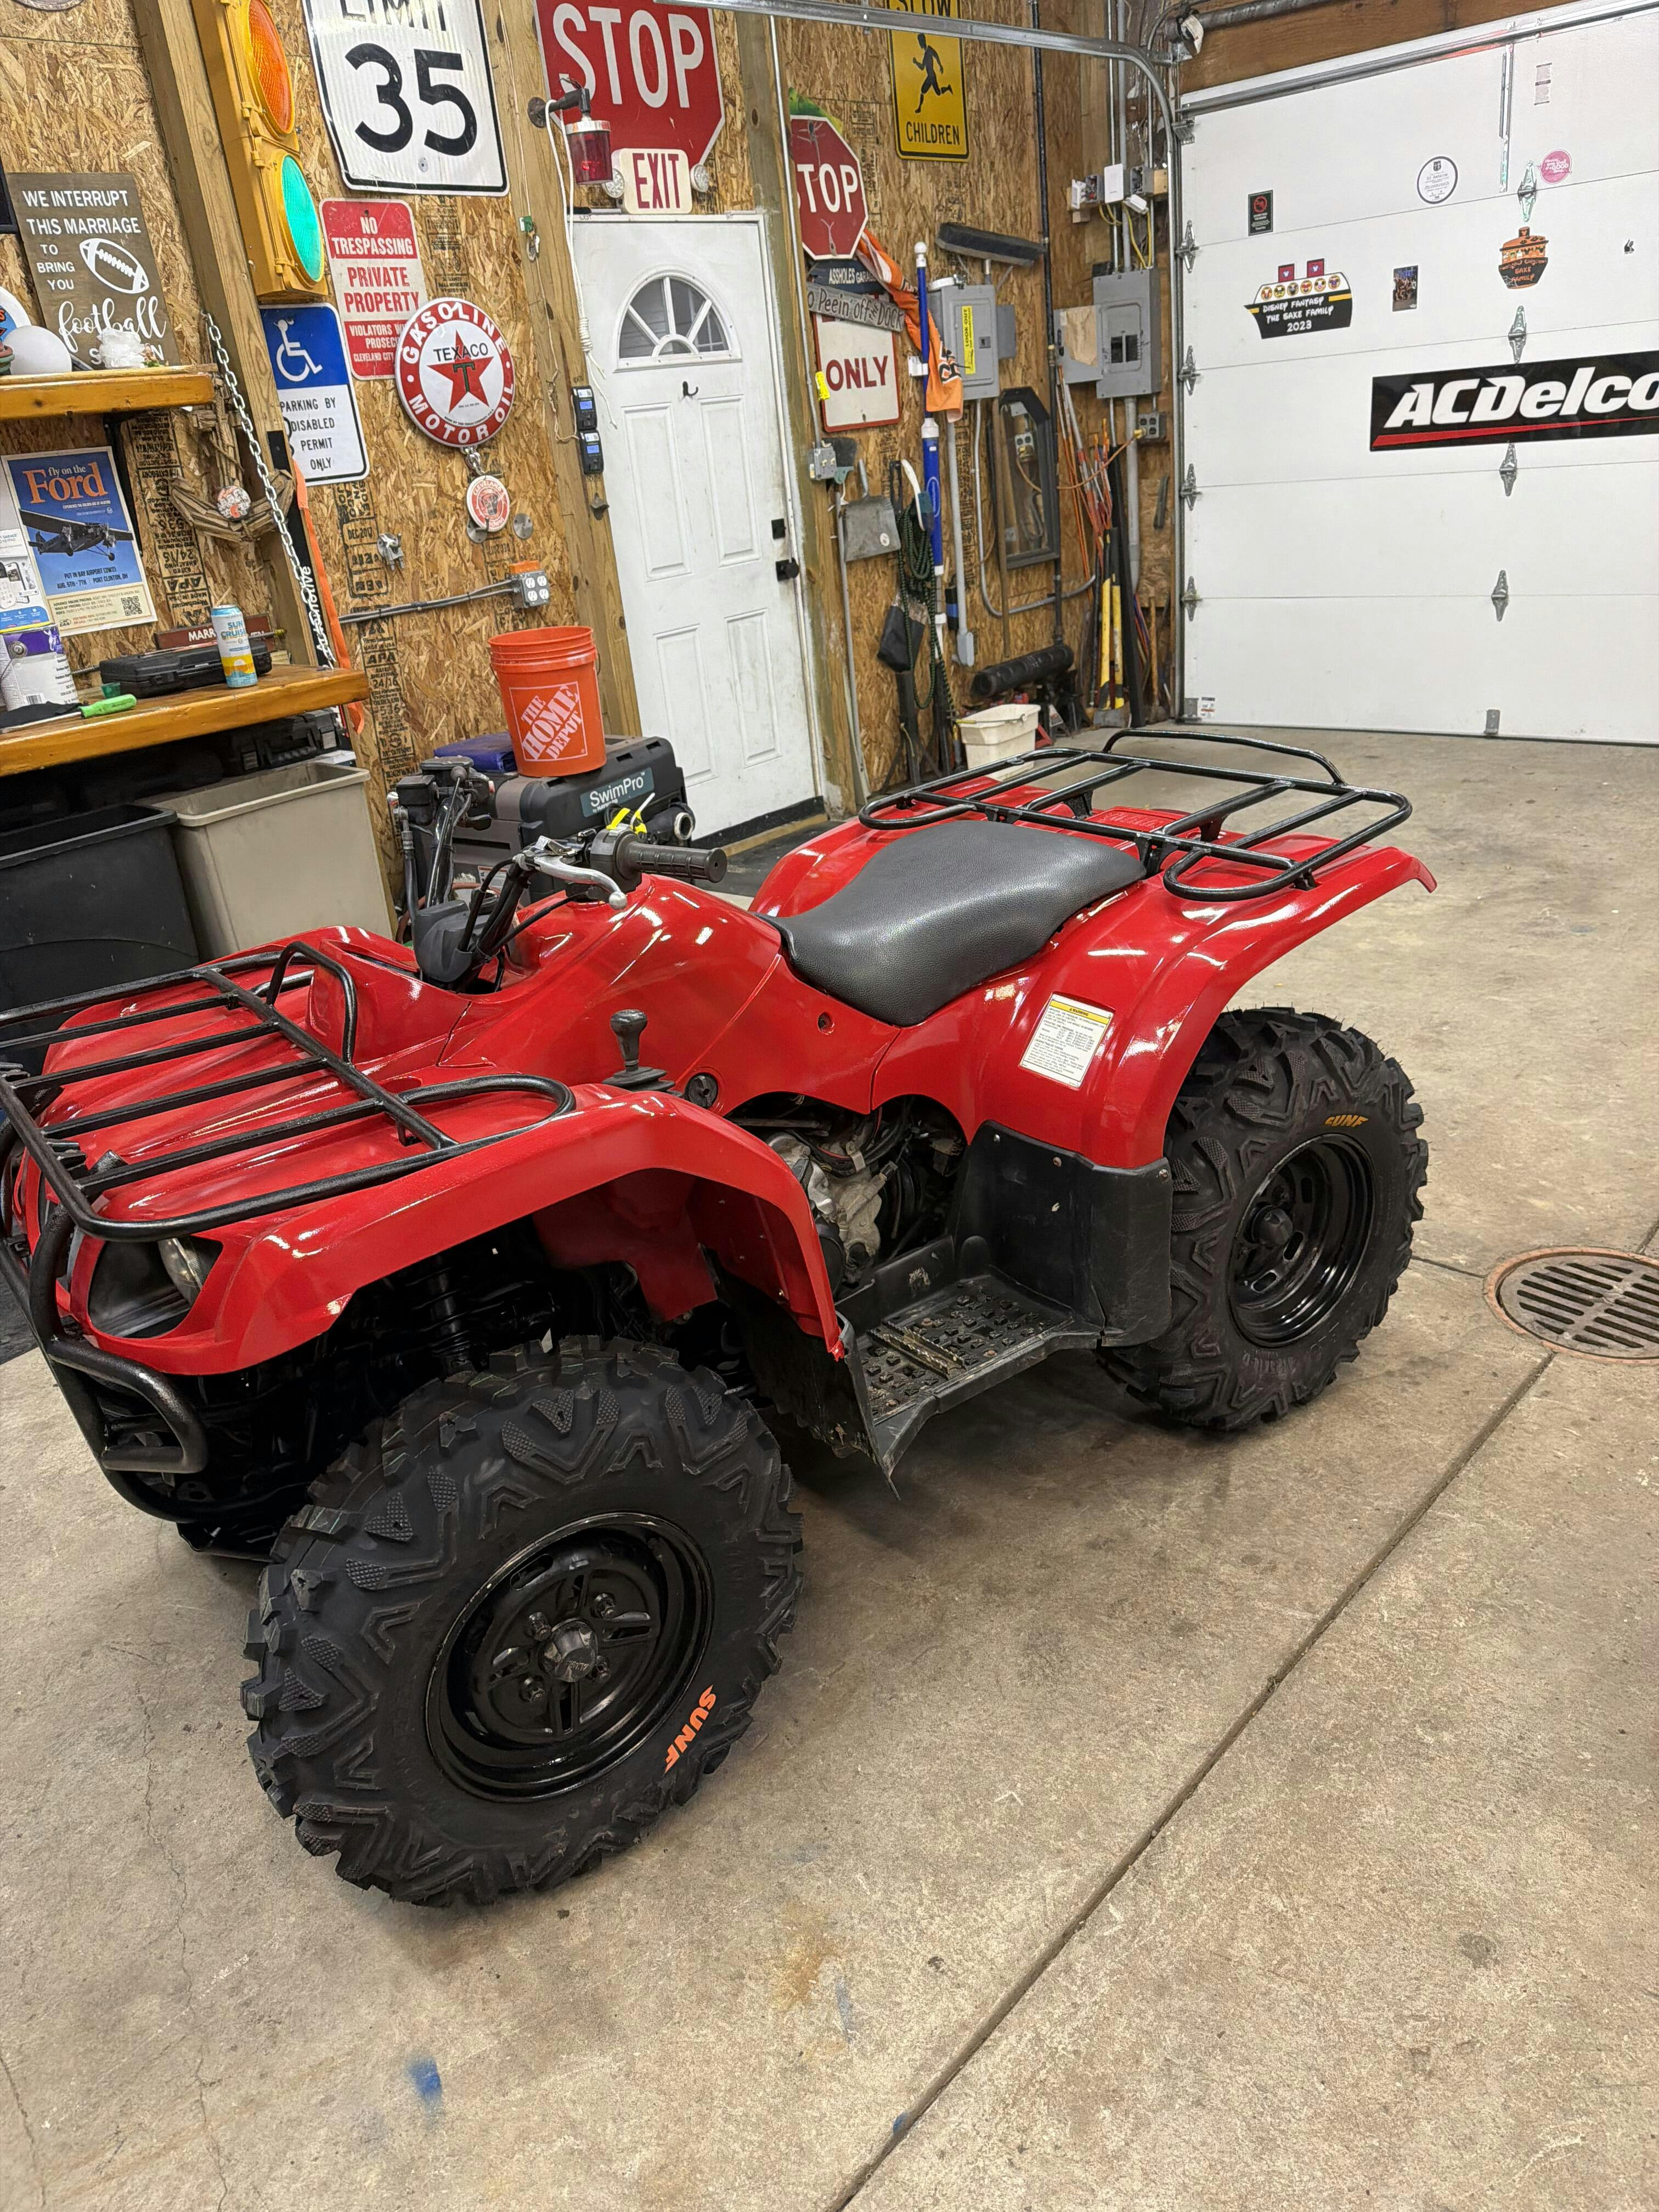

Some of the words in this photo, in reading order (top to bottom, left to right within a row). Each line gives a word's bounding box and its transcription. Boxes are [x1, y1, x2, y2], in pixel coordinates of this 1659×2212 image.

[553, 3, 704, 108] STOP
[345, 43, 477, 156] 35
[906, 122, 960, 145] CHILDREN
[632, 153, 681, 210] EXIT
[797, 163, 858, 213] TOP
[22, 190, 49, 207] WE
[53, 190, 128, 207] INTERRUPT
[26, 219, 61, 235] THIS
[64, 218, 141, 235] MARRIAGE
[360, 217, 378, 234] NO
[40, 245, 58, 255] TO
[331, 237, 414, 256] TRESPASSING
[36, 262, 75, 273] BRING
[829, 268, 855, 285] ASSHOLES
[48, 279, 75, 290] YOU
[347, 266, 410, 288] PRIVATE
[344, 291, 419, 313] PROPERTY
[1263, 302, 1288, 313] DISNEY
[1291, 296, 1324, 308] FANTASY
[878, 304, 904, 329] DOCK
[1266, 314, 1279, 324] THE
[1283, 311, 1302, 320] SAXE
[1306, 306, 1334, 317] FAMILY
[58, 296, 167, 353] football
[349, 324, 393, 336] VIOLATORS
[403, 302, 507, 364] GASOLINE
[1286, 320, 1312, 332] 2023
[353, 352, 382, 362] CLEVELAND
[433, 343, 488, 362] TEXACO
[826, 356, 888, 391] ONLY
[280, 399, 318, 413] PARKING
[325, 397, 336, 409] BY
[1384, 366, 1659, 428] ACDelco
[409, 394, 489, 443] MOTOR
[495, 383, 514, 422] OIL
[291, 417, 335, 432] DISABLED
[301, 438, 333, 451] PERMIT
[48, 467, 60, 477] fly
[73, 465, 86, 473] the
[311, 458, 331, 470] ONLY
[22, 461, 108, 504] Ford
[473, 480, 502, 495] CLEVELAND
[227, 620, 243, 629] SUN
[521, 695, 546, 725] THE
[522, 686, 580, 760] HOME
[546, 710, 582, 759] DEPOT
[1323, 1114, 1369, 1128] SUNF
[664, 1685, 716, 1774] SUNF
